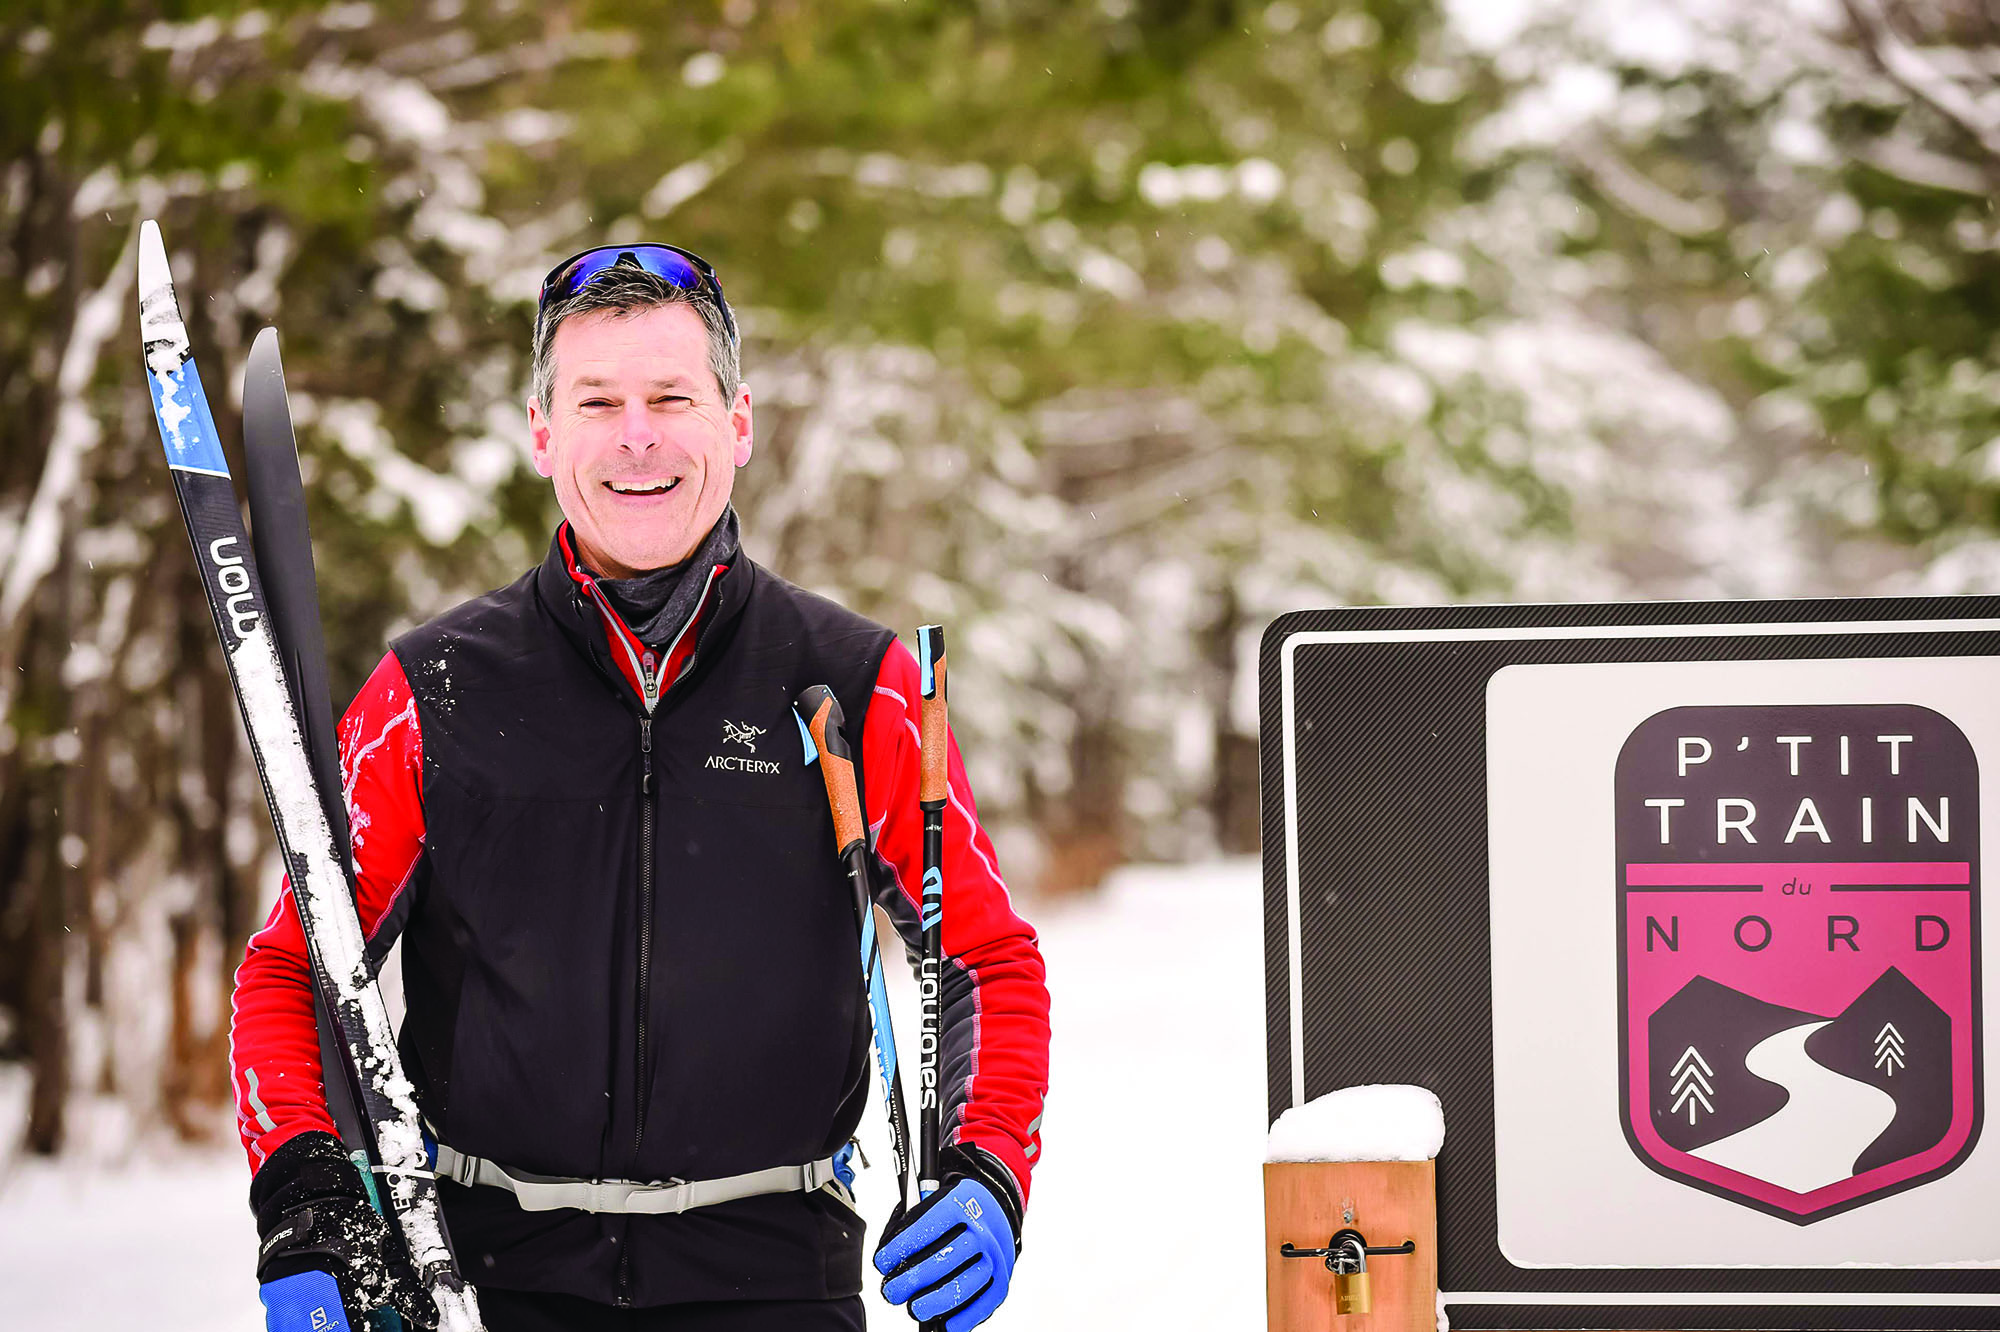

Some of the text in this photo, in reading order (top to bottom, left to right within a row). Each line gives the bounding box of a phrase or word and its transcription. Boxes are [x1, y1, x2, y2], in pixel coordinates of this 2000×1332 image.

[209, 535, 259, 640] mon
[1677, 735, 1914, 777] P'TIT
[1644, 796, 1950, 845] TRAIN
[1781, 876, 1812, 896] du
[1645, 914, 1951, 952] NORD
[921, 957, 938, 1110] salomon
